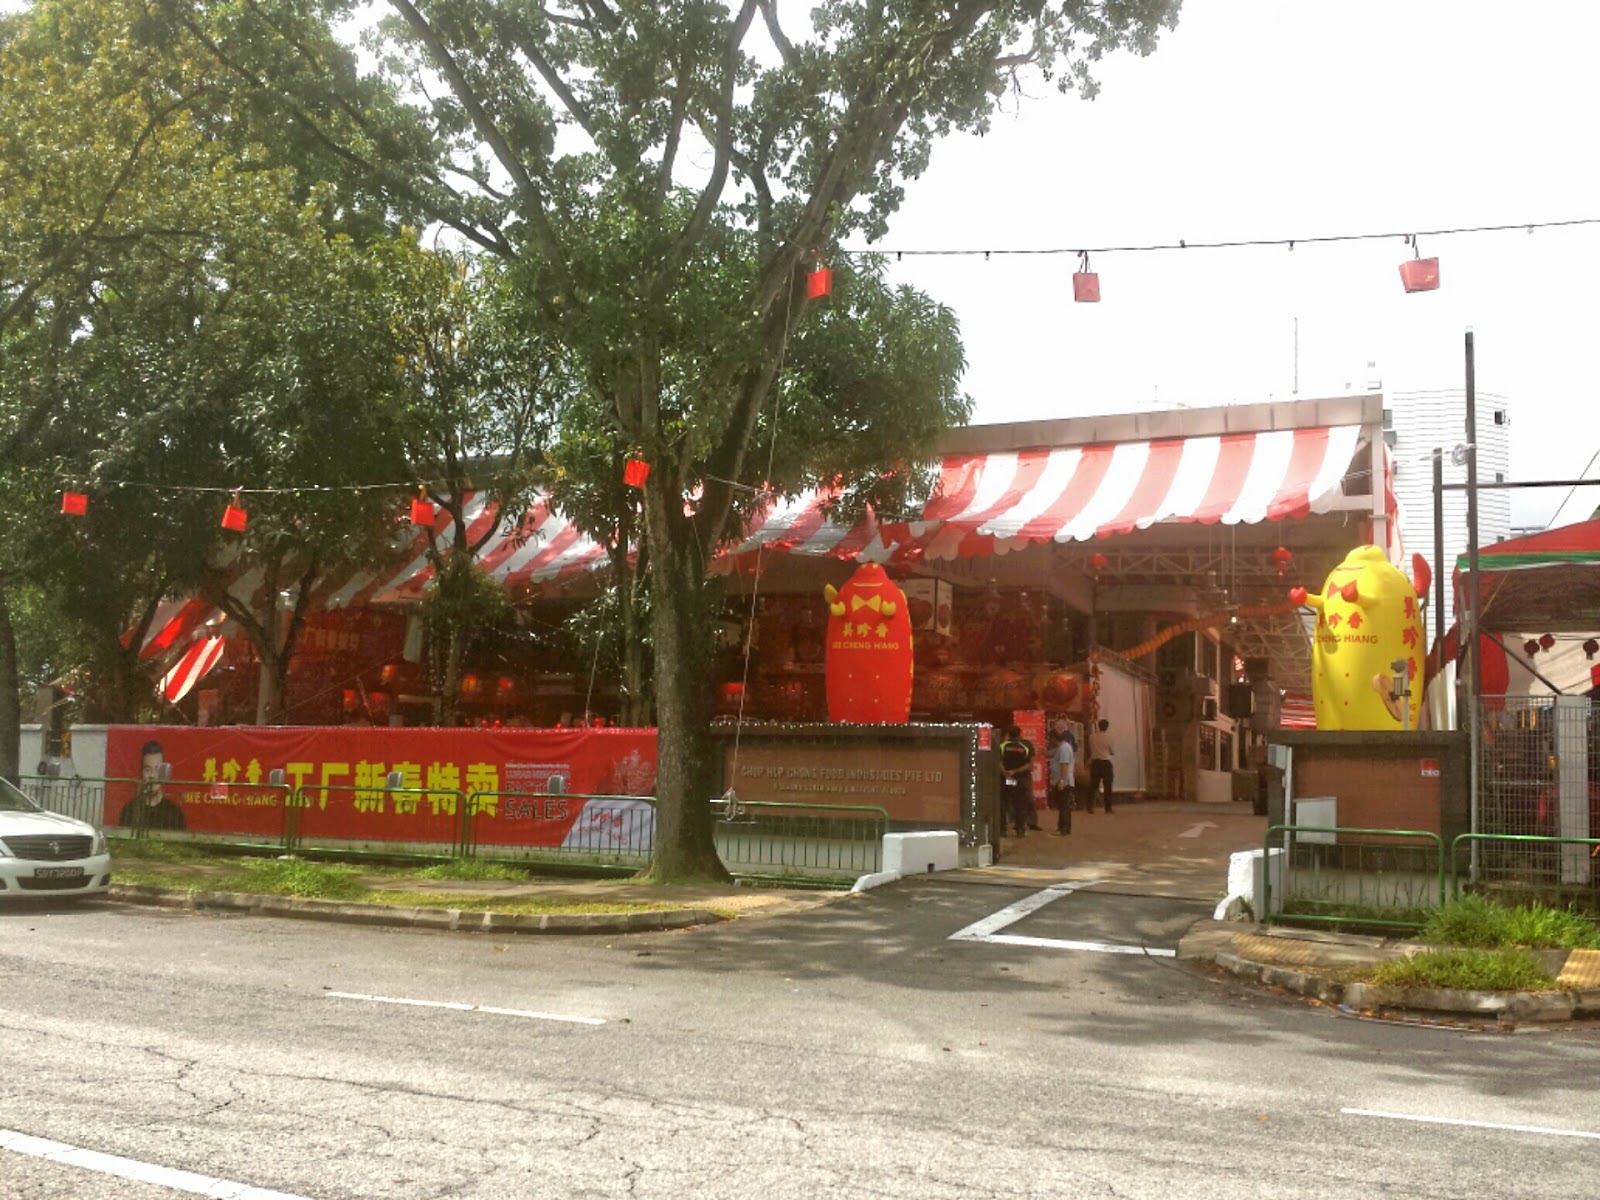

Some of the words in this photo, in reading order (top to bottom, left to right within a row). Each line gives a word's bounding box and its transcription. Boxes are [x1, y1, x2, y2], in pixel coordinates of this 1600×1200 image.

[1344, 635, 1378, 644] HIANG
[905, 770, 922, 782] PTE
[505, 781, 571, 795] FACTY
[505, 799, 567, 819] SALES
